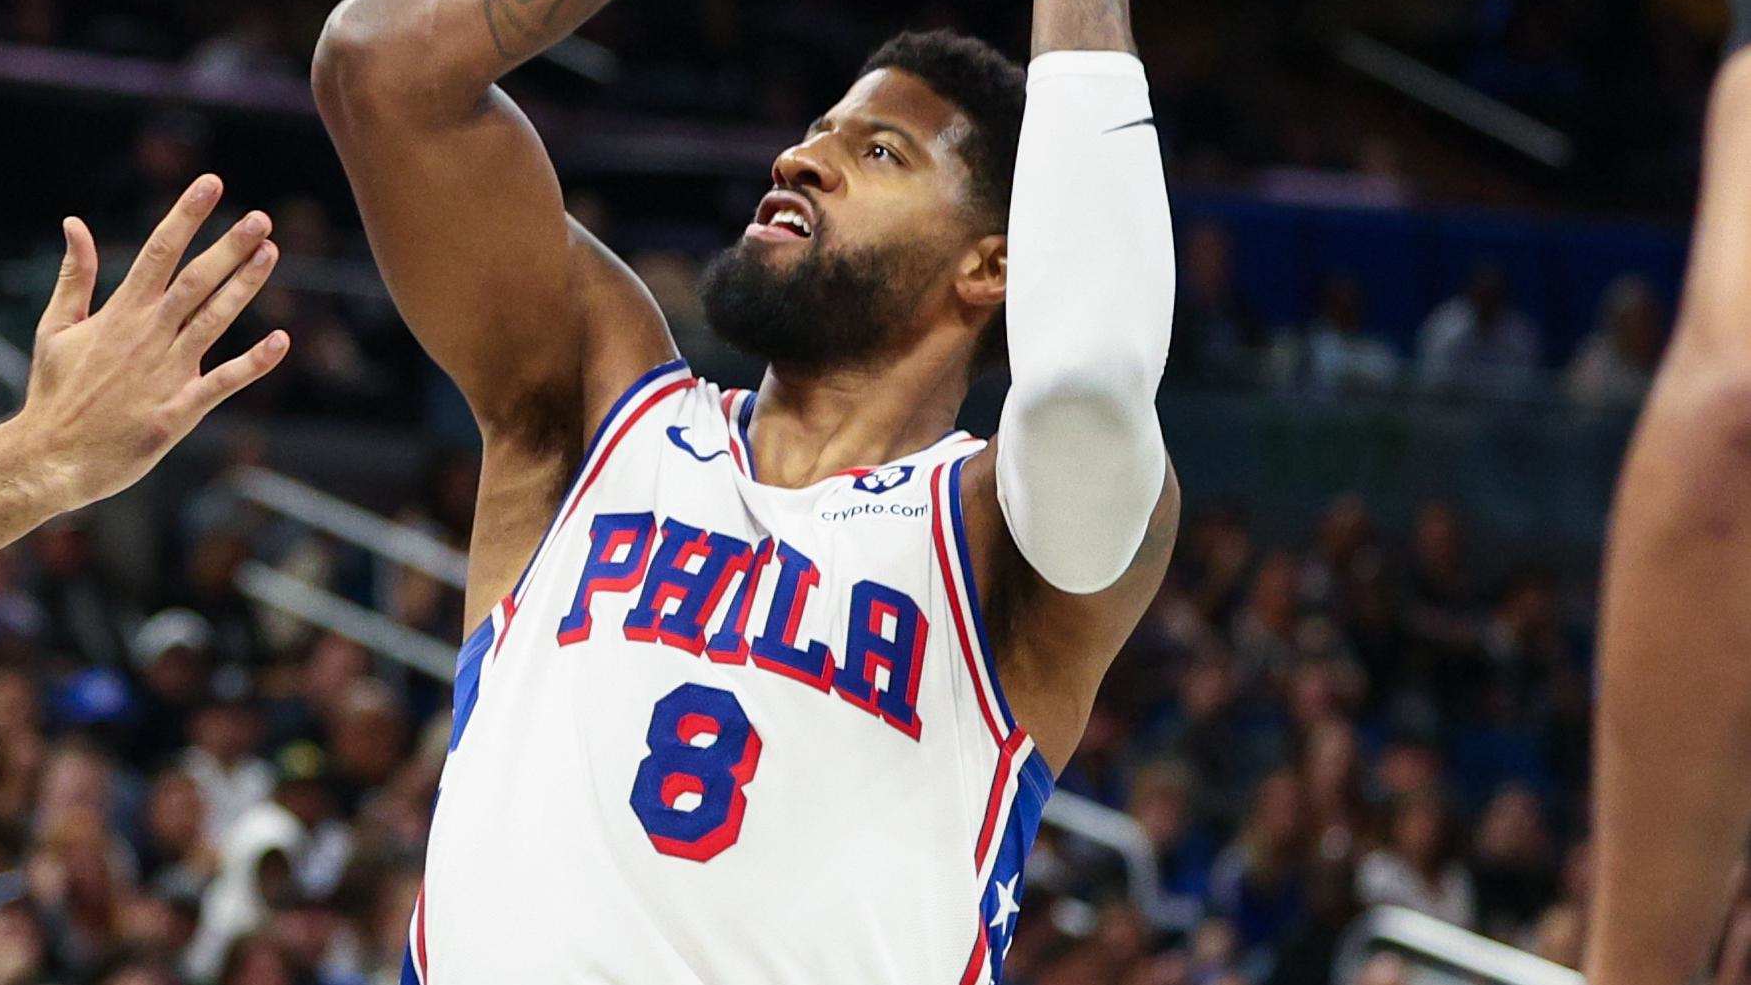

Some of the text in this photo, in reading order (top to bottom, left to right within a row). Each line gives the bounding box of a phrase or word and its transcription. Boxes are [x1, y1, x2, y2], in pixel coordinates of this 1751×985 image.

[821, 503, 928, 522] crypto.com
[556, 511, 930, 743] PHILA
[629, 681, 763, 863] 8
